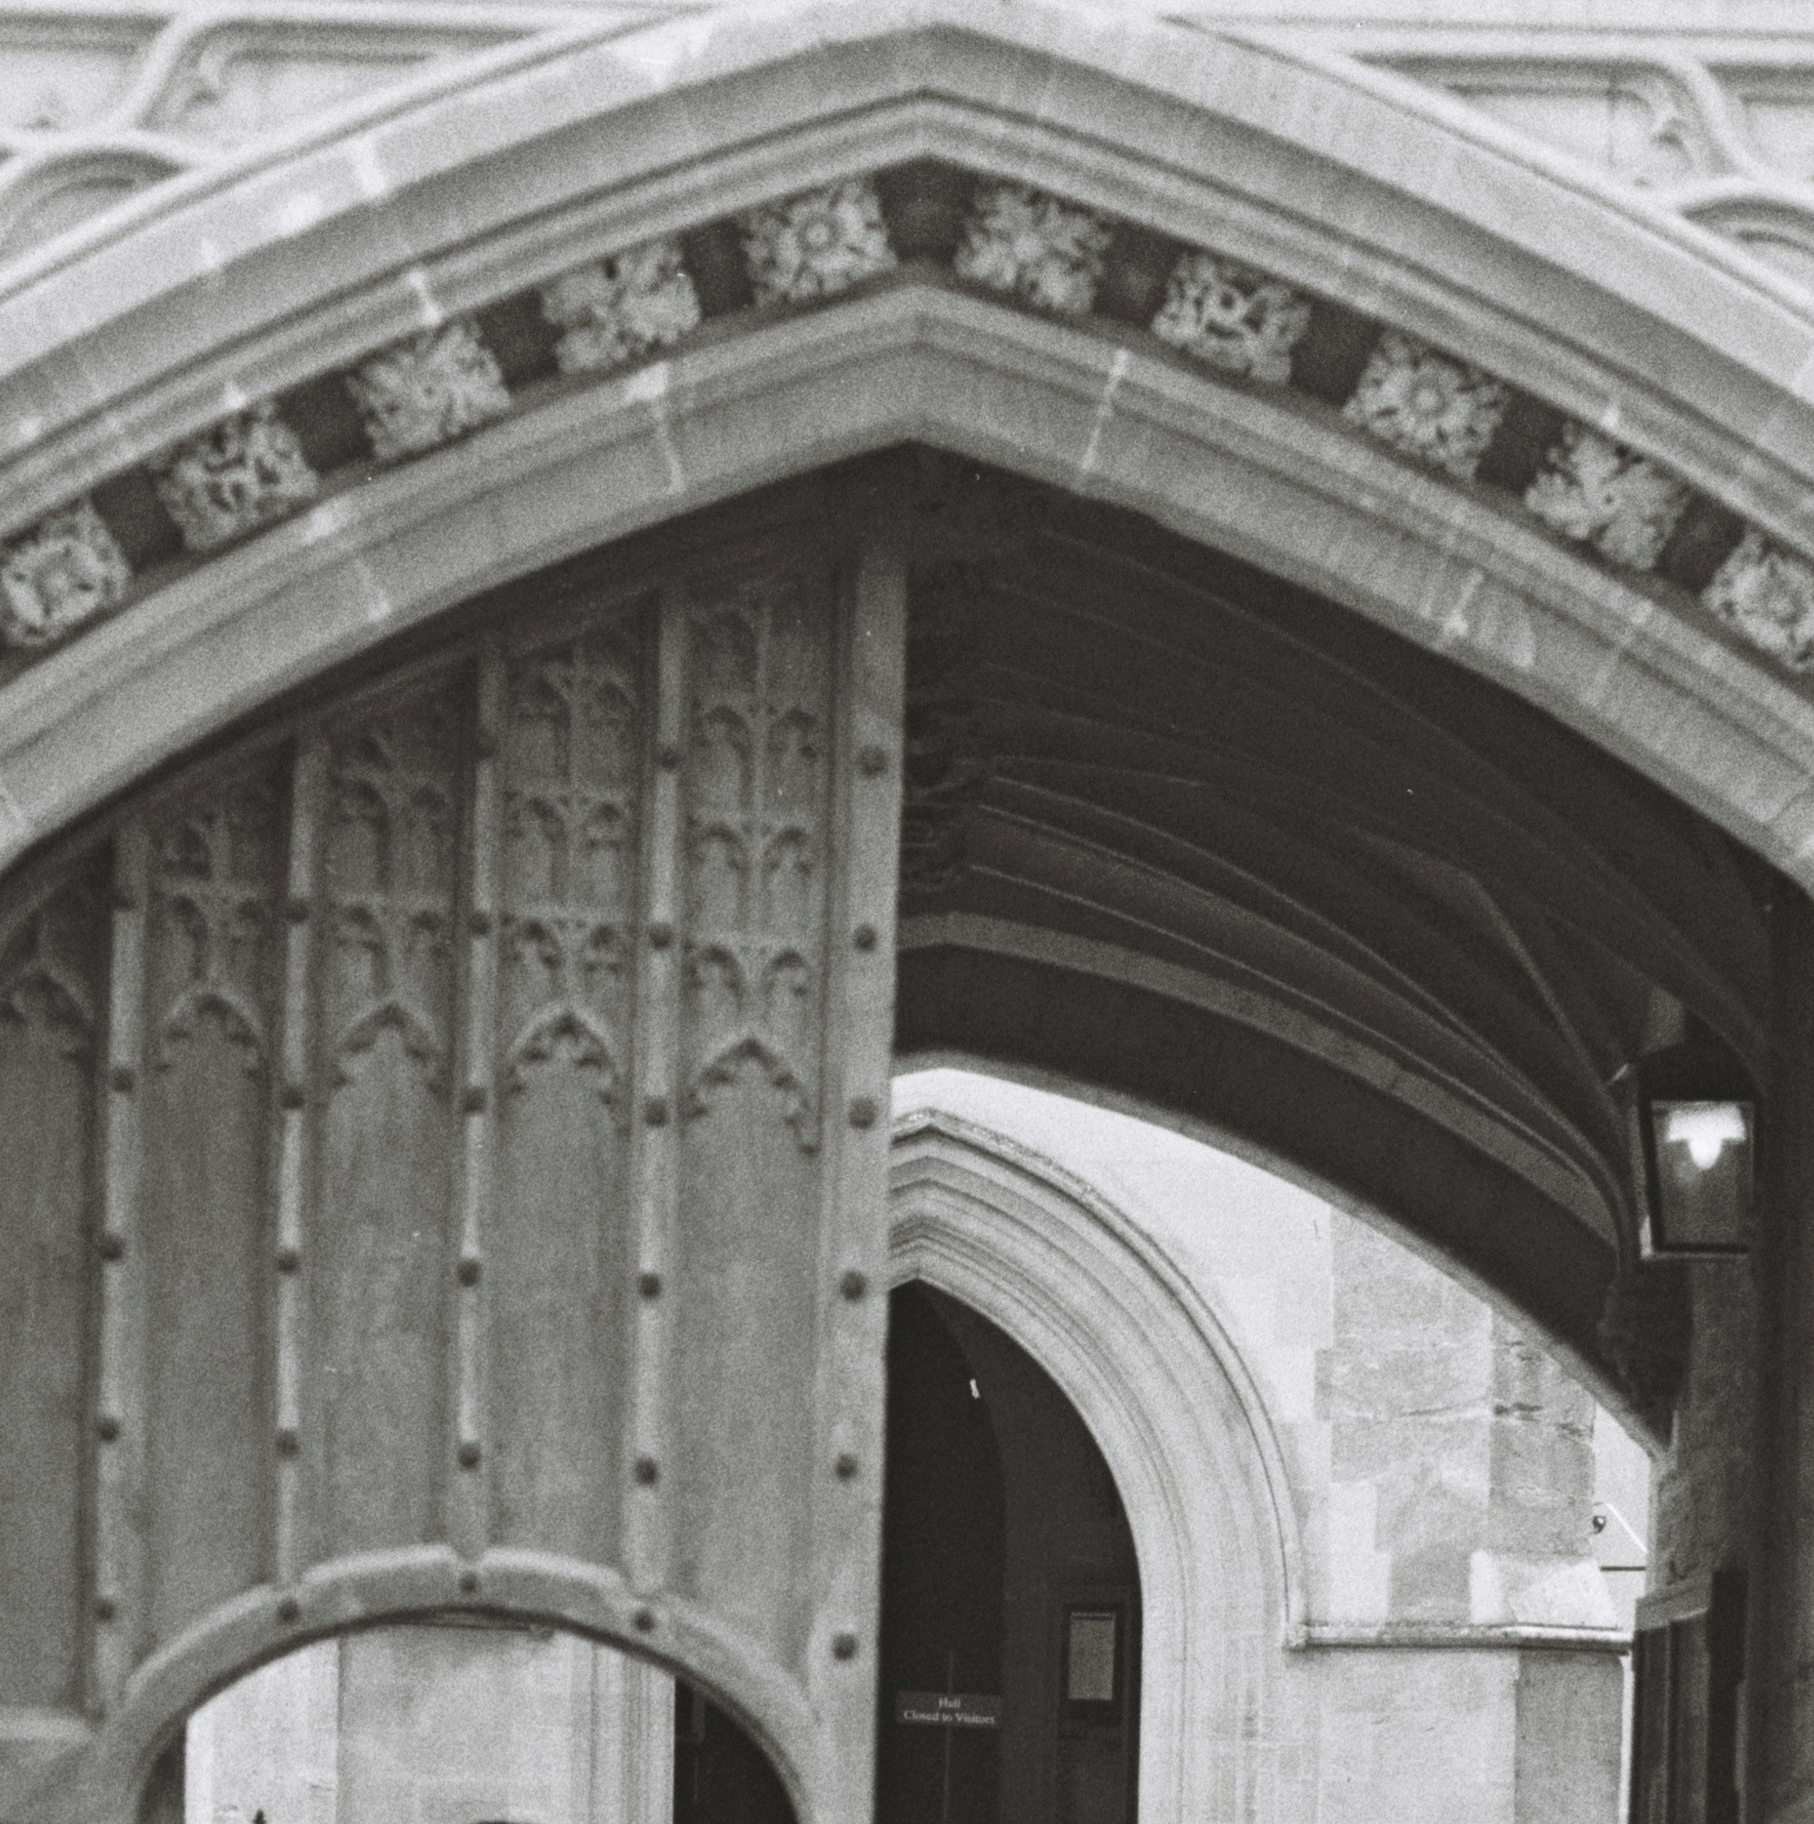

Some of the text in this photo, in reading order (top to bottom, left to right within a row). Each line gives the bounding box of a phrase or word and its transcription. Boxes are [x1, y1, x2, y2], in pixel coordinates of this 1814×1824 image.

[939, 1697, 961, 1708] Hall
[903, 1710, 995, 1724] Closed to Visitors
